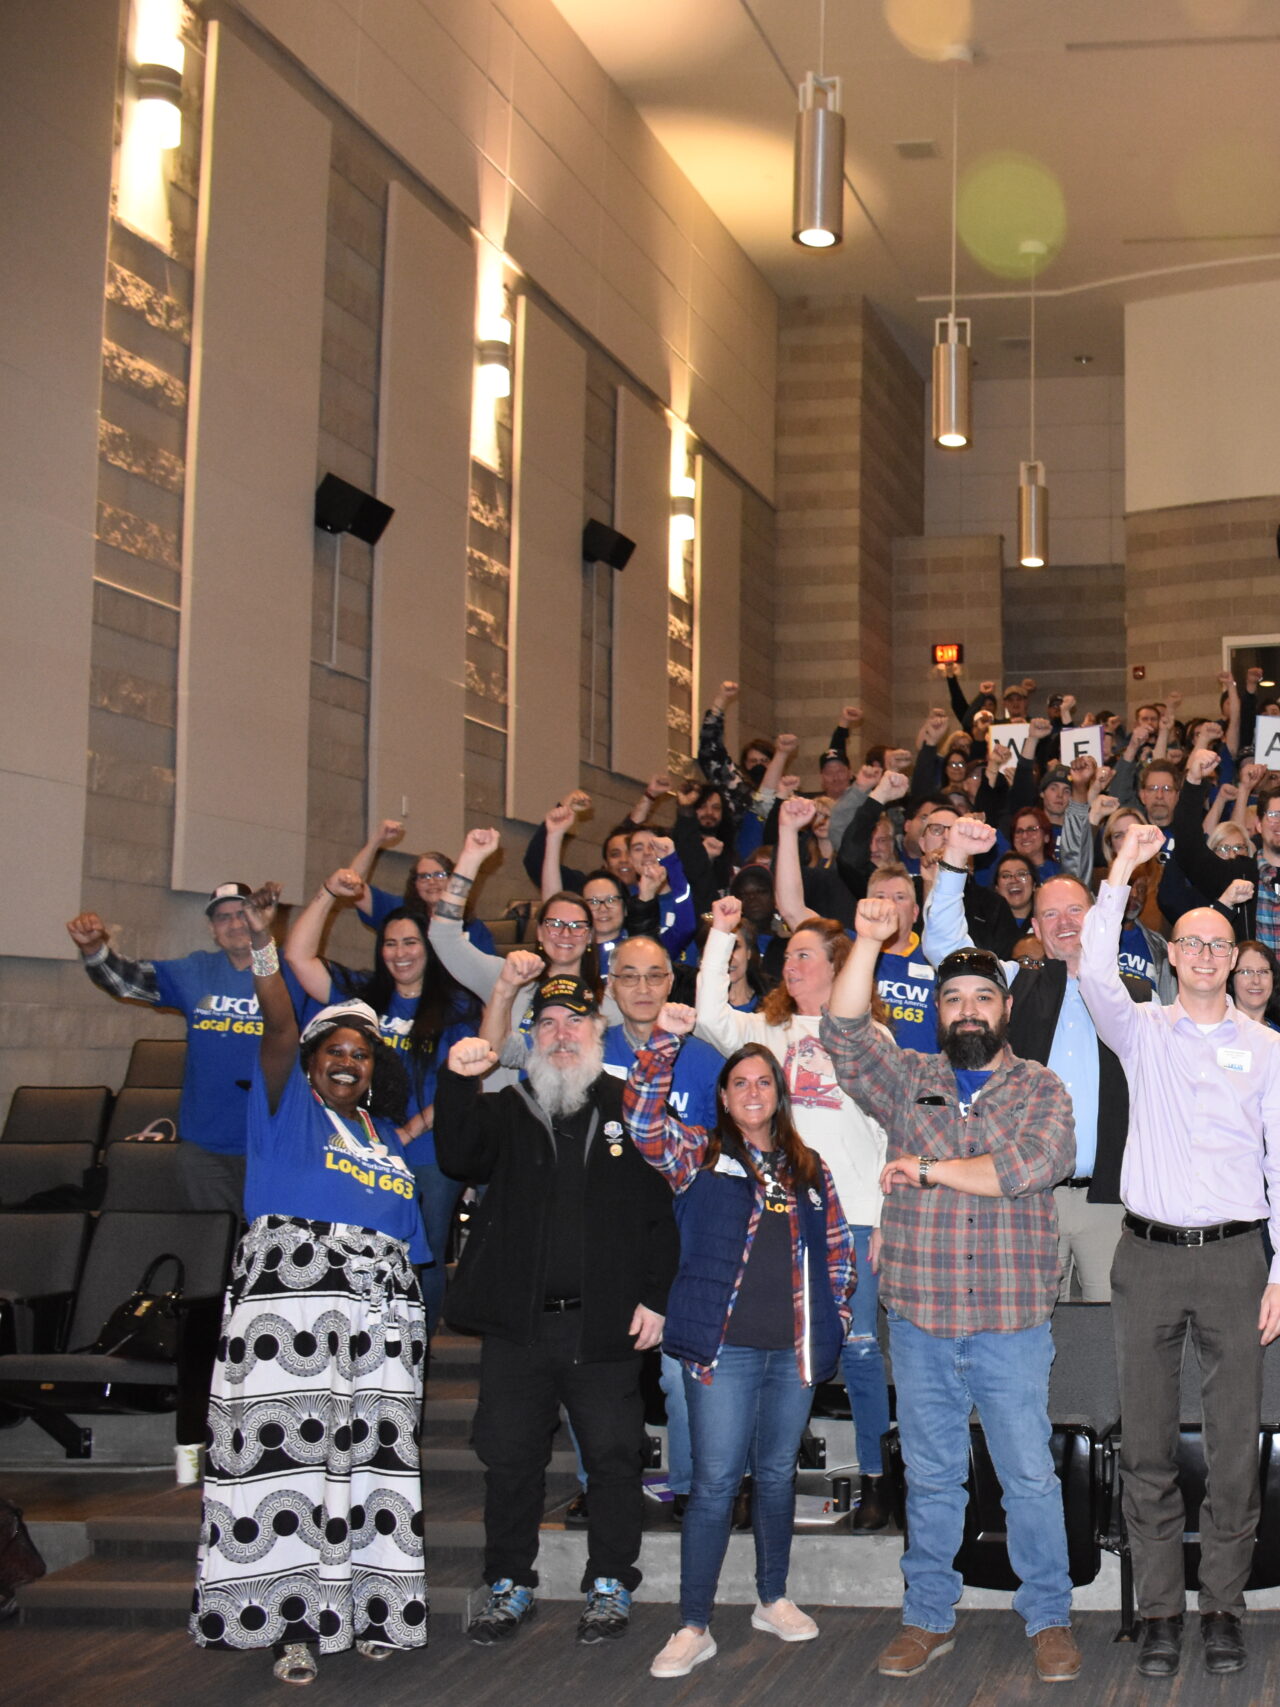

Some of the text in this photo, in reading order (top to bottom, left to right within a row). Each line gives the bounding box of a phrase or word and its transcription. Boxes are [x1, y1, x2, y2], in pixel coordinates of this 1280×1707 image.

[892, 1005, 925, 1024] 663
[232, 1021, 264, 1036] 663
[325, 1152, 375, 1188] Local
[378, 1174, 414, 1200] 663
[765, 1200, 791, 1213] Loc
